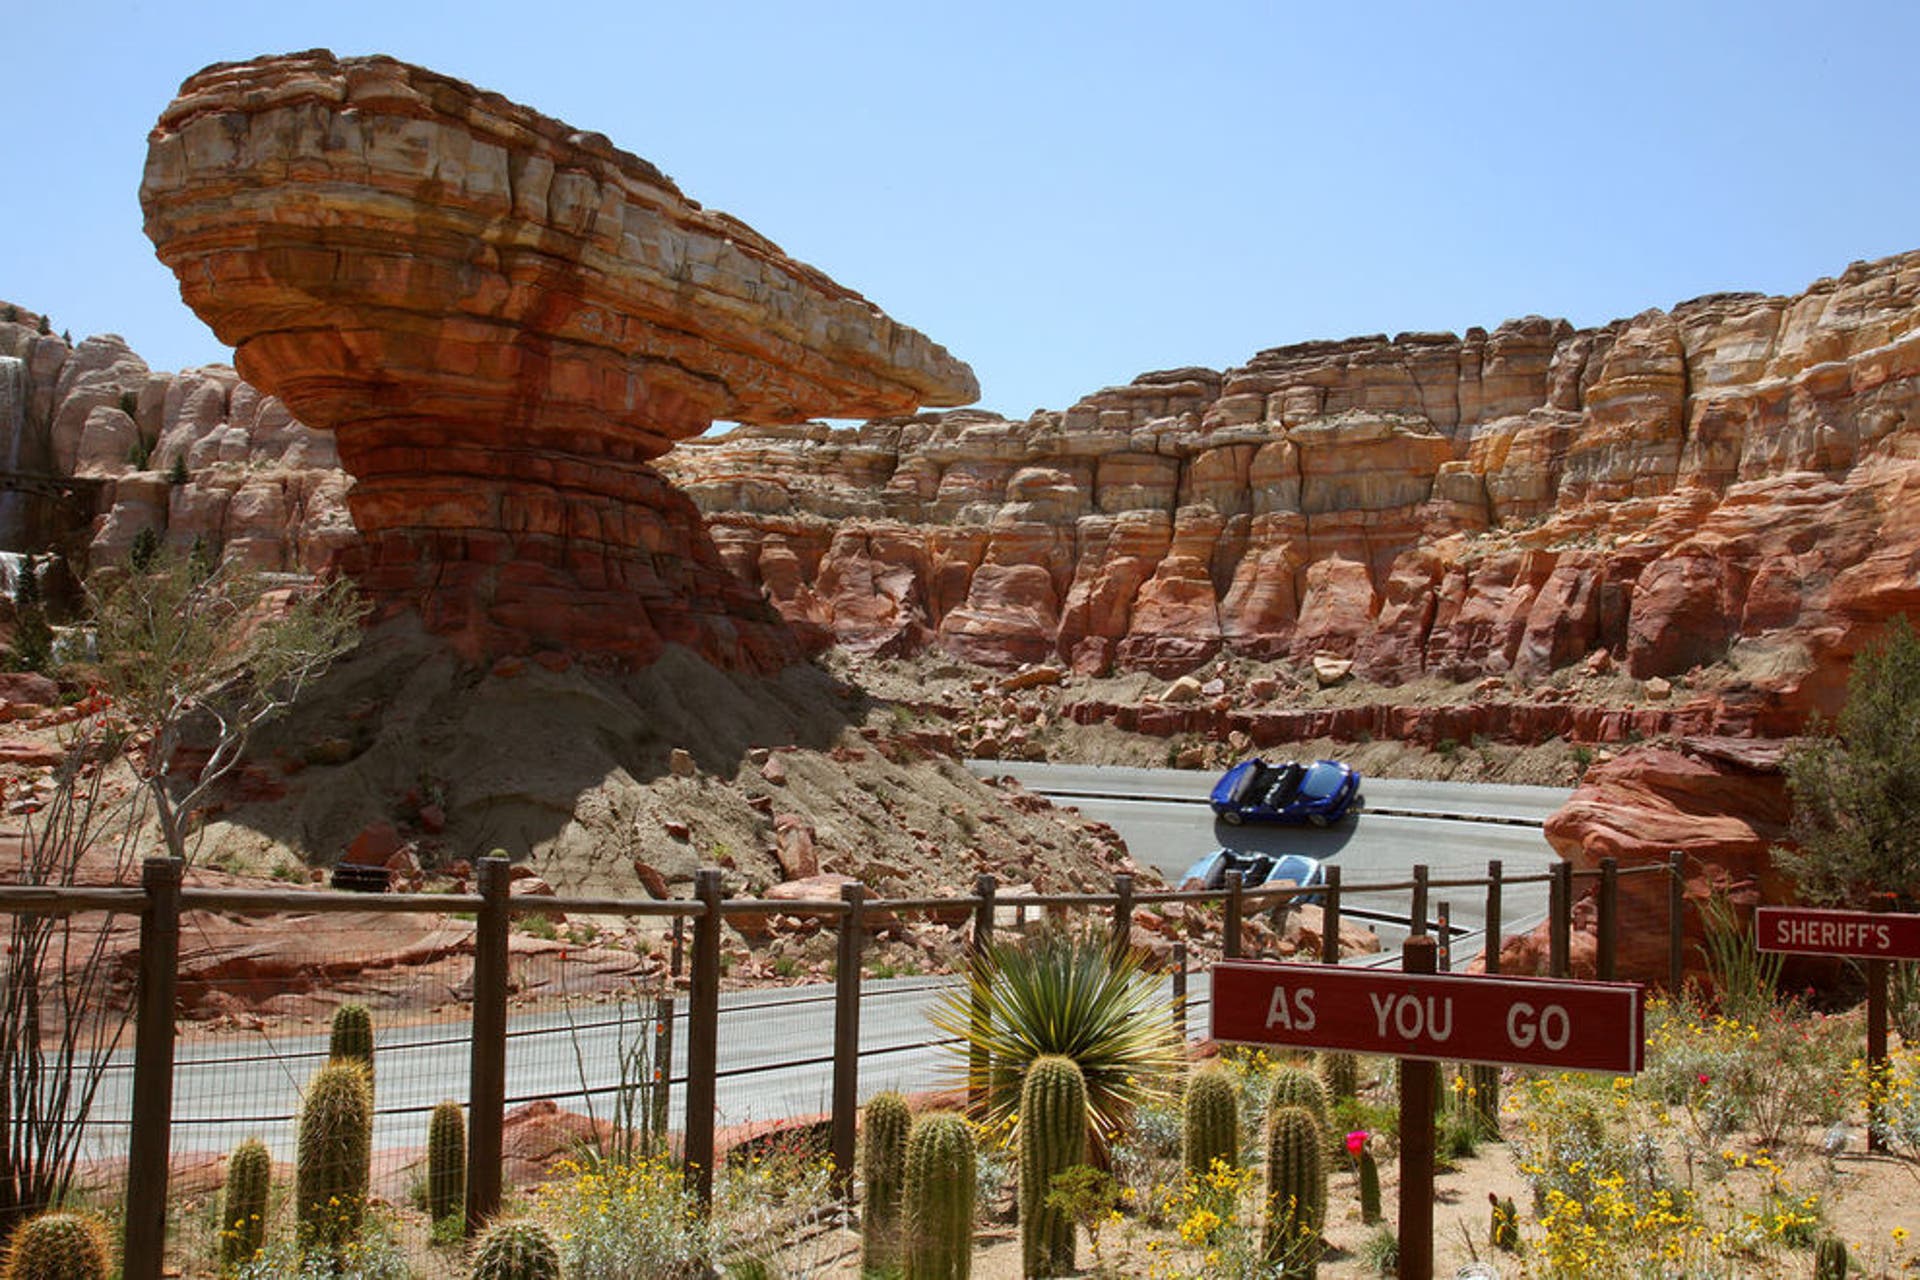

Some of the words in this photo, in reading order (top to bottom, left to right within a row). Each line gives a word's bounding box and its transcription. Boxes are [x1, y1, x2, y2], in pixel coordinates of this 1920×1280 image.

[1777, 920, 1890, 949] SHERIFF'S
[1266, 987, 1316, 1031] AS
[1371, 993, 1453, 1041] YOU
[1508, 1002, 1570, 1050] GO
